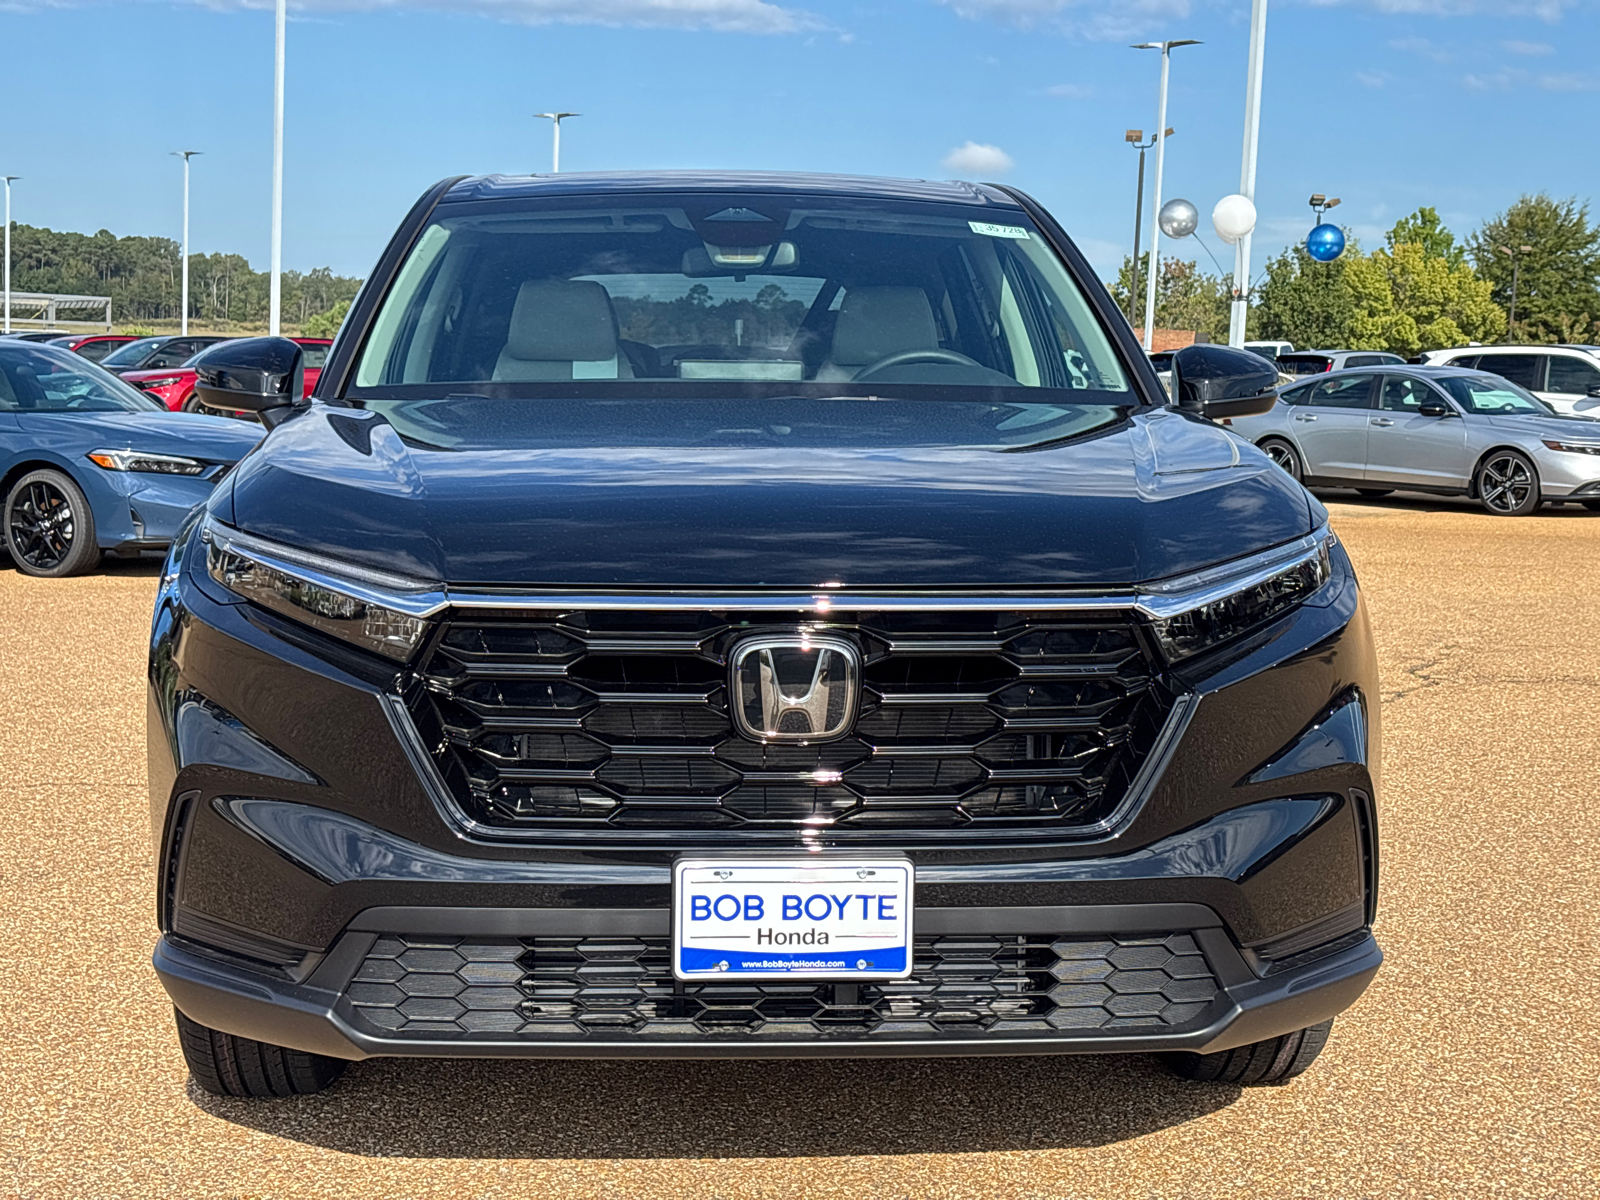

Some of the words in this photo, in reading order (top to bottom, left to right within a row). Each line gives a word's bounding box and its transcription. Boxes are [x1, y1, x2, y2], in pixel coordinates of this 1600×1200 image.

[690, 894, 764, 921] BOB
[782, 893, 898, 921] BOYTE
[757, 928, 829, 945] Honda
[742, 959, 845, 970] www.BobBoyteHonda.com
